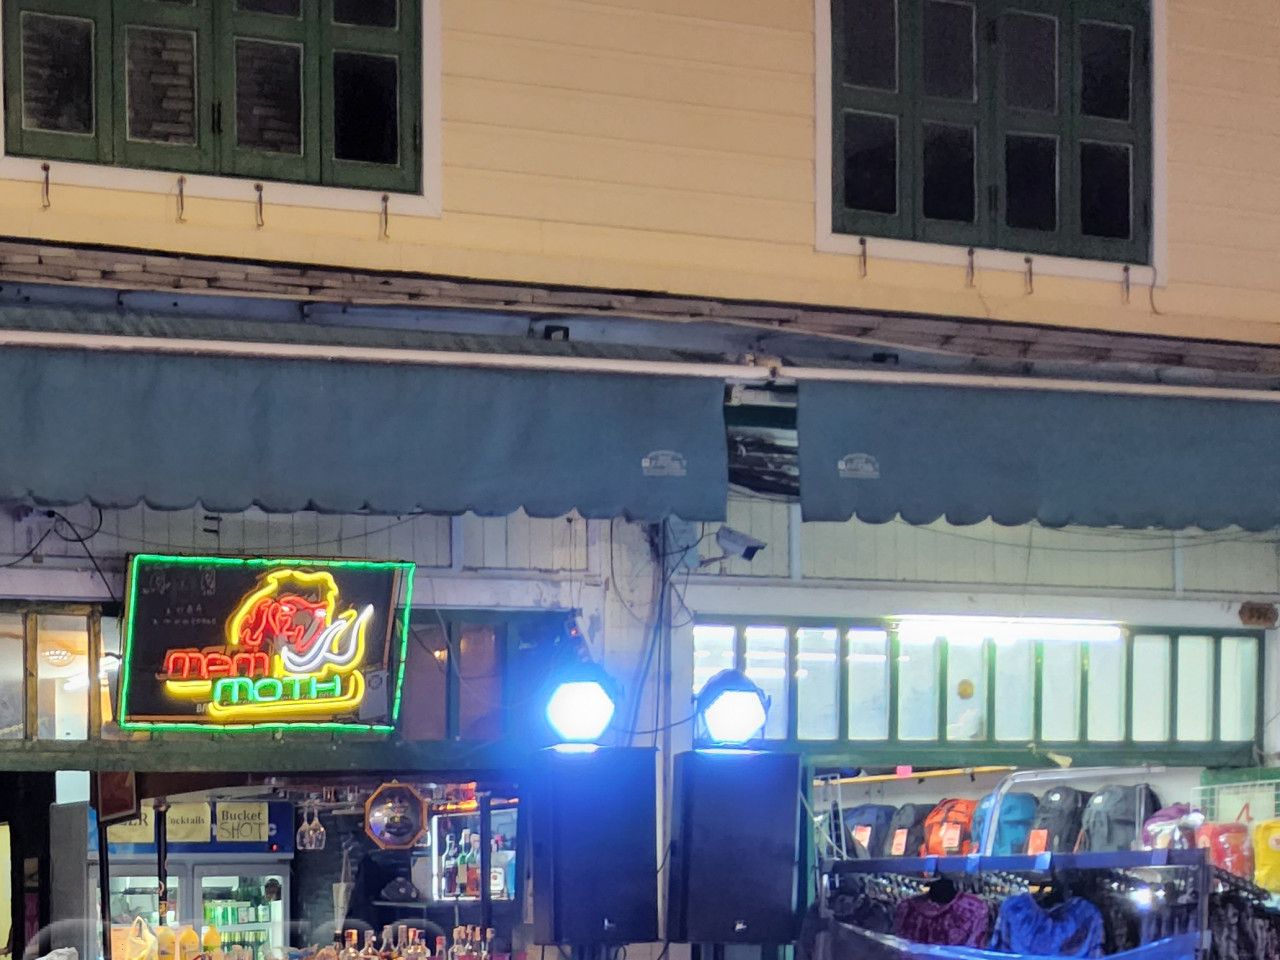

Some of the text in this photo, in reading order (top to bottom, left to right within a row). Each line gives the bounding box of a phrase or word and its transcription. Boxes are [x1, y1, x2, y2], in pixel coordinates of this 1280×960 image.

[213, 674, 342, 704] MOTH
[169, 815, 205, 825] ocktails
[221, 810, 262, 821] Bucket
[220, 821, 265, 840] SHOT
